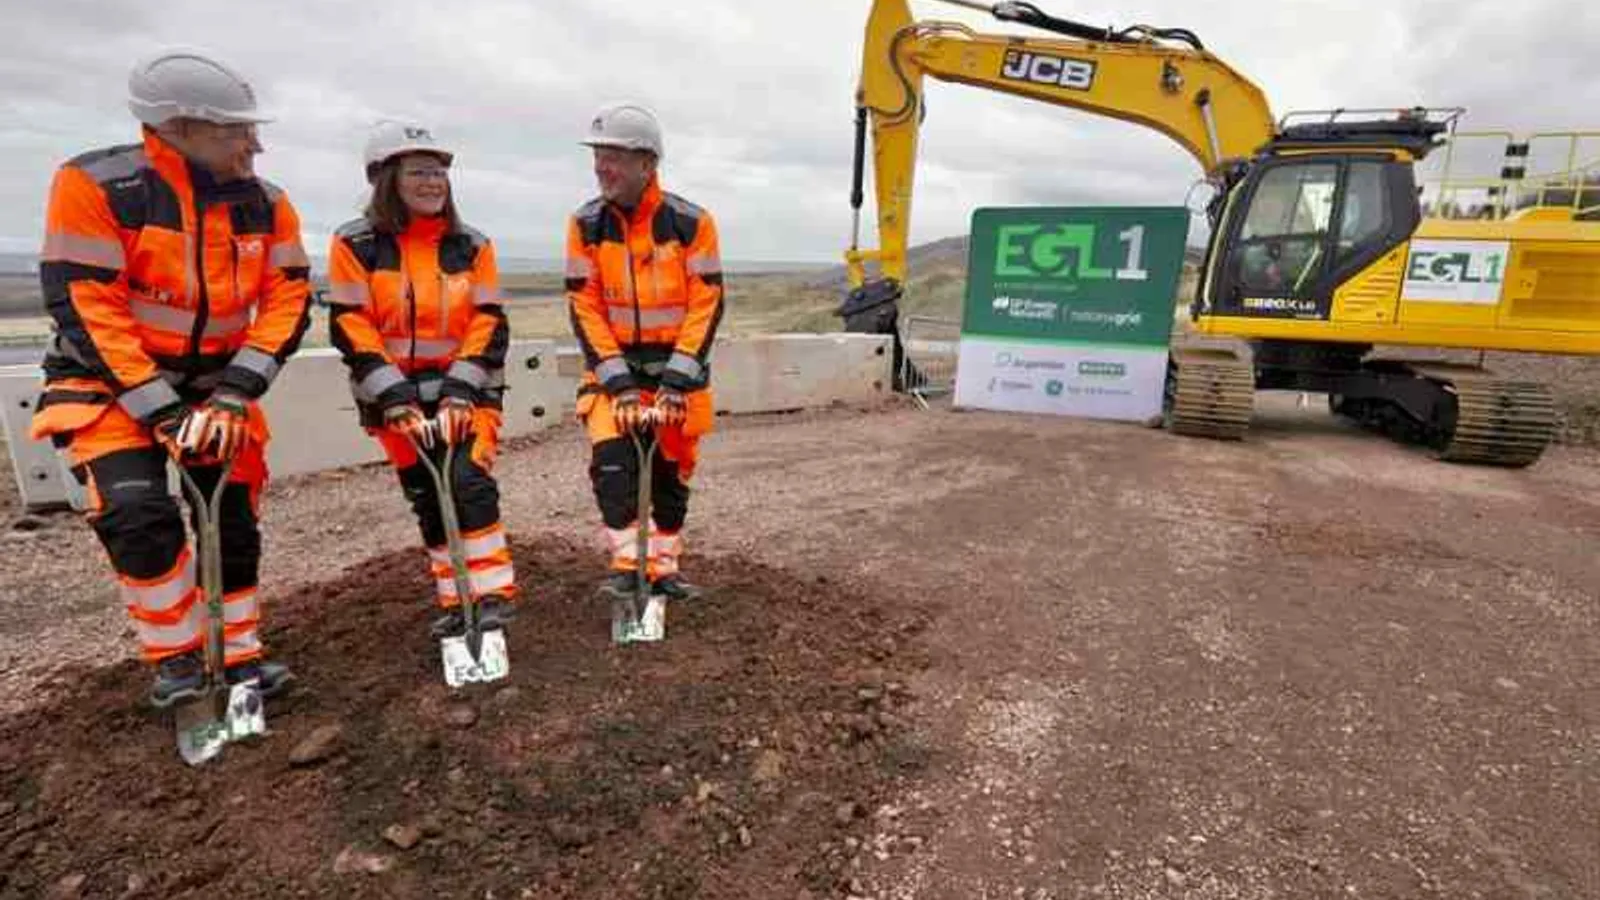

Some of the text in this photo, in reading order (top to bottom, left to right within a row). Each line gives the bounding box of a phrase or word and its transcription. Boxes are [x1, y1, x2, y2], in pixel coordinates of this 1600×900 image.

[1004, 51, 1094, 89] JCB
[994, 222, 1149, 280] EGL1
[1407, 251, 1502, 283] EGL1
